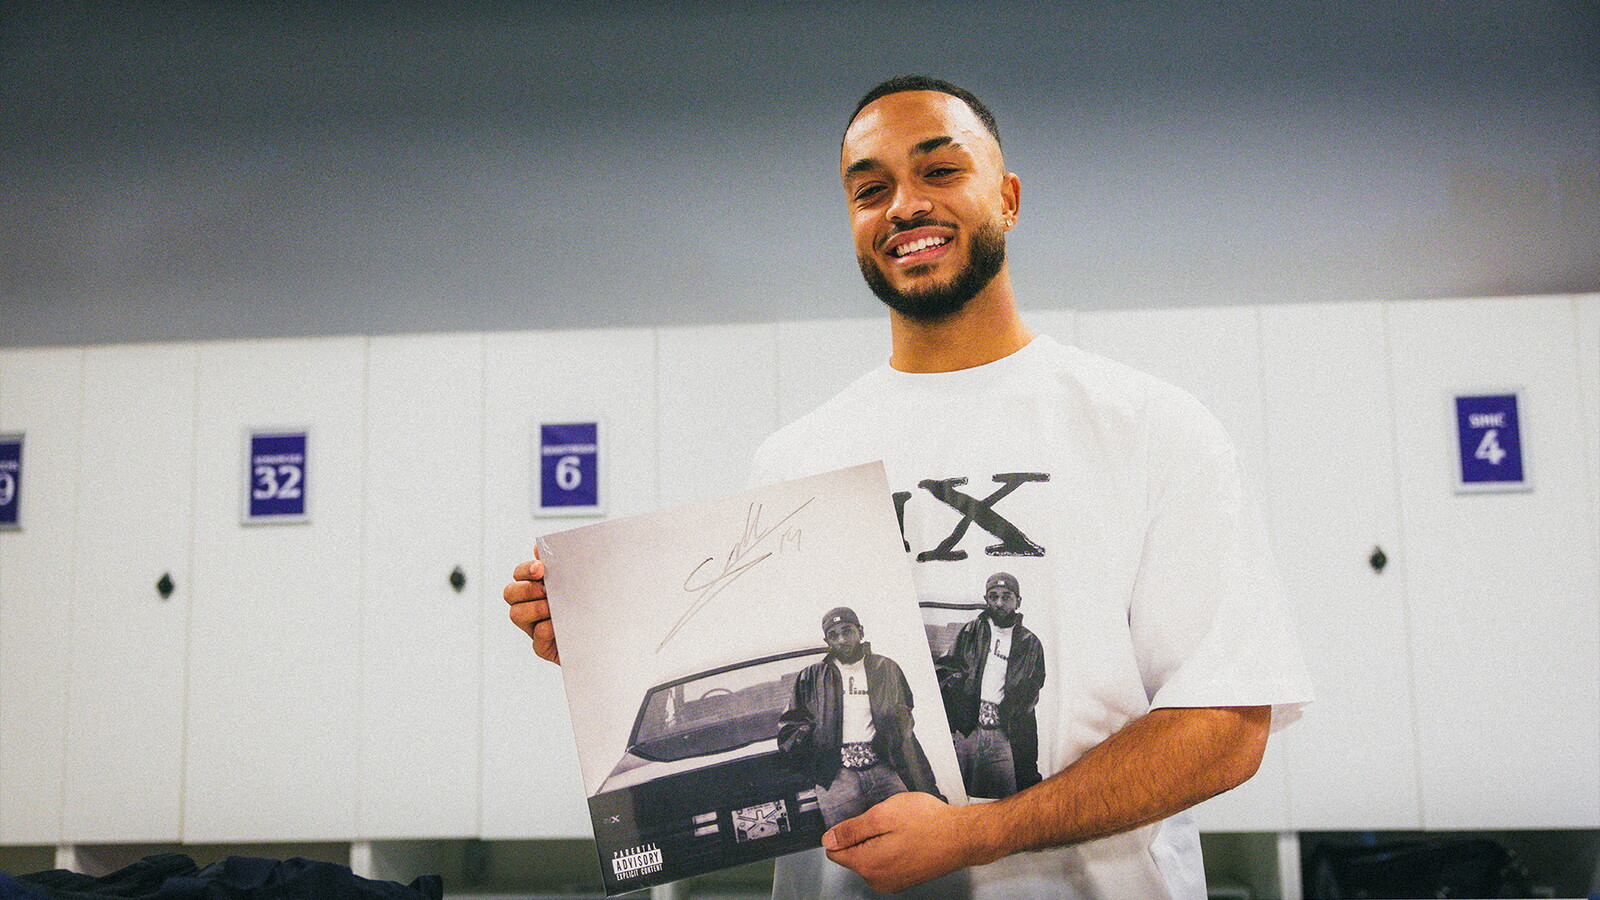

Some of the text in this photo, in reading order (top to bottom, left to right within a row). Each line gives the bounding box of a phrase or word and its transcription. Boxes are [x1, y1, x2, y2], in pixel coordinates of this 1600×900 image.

[1474, 429, 1507, 465] 4
[252, 465, 302, 500] 32
[556, 455, 582, 491] 6
[892, 472, 1051, 563] X
[613, 842, 657, 859] PARENTAL
[616, 851, 660, 872] ADVISORY
[616, 863, 663, 881] EXPLICIT CONTENT
